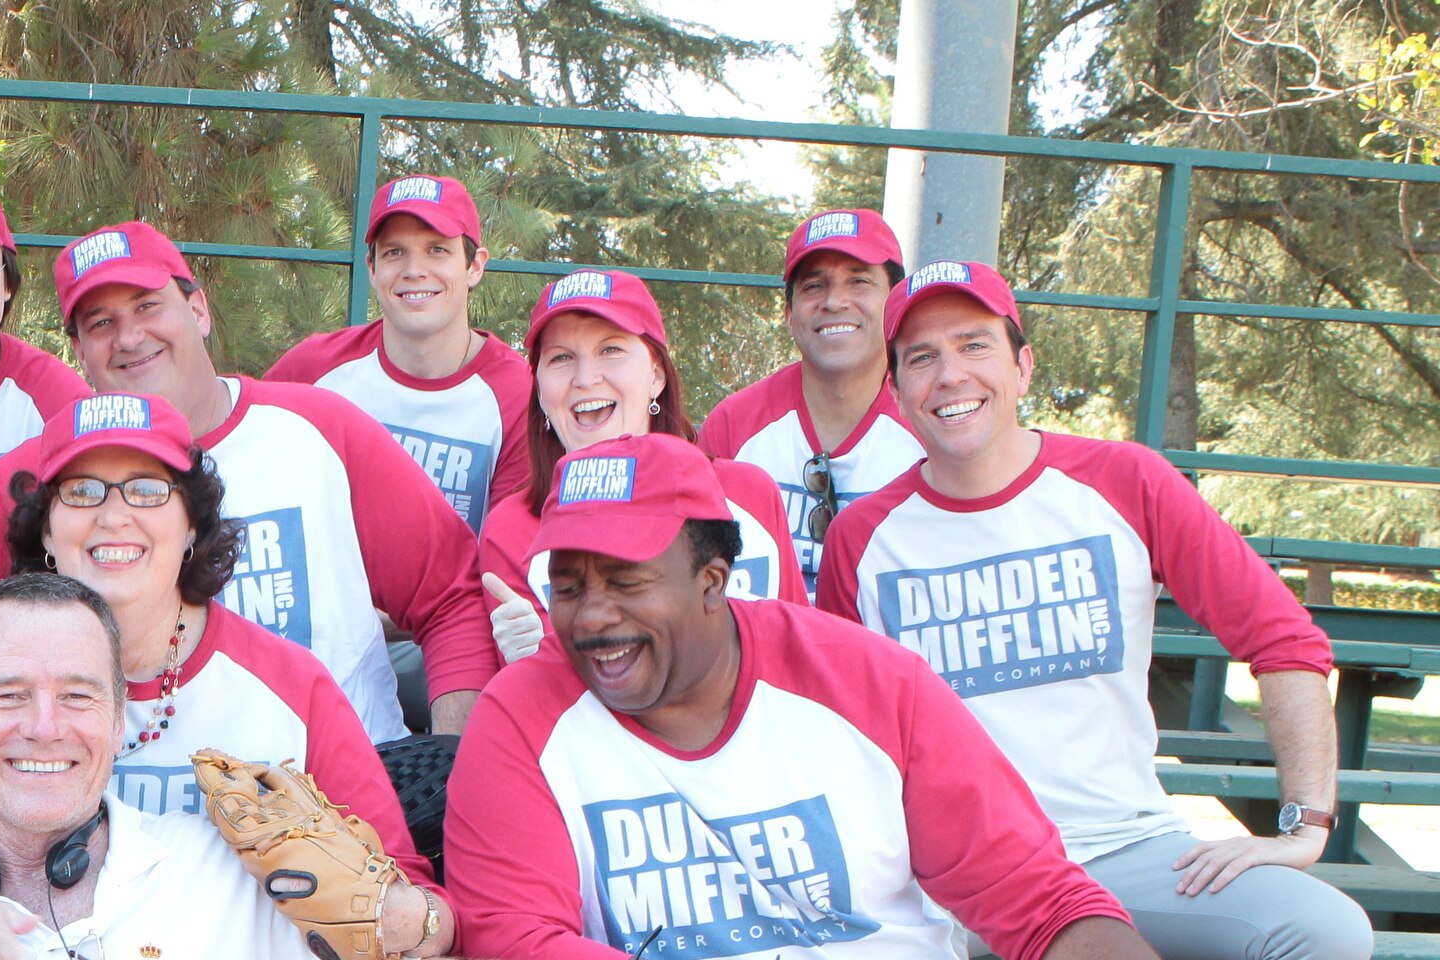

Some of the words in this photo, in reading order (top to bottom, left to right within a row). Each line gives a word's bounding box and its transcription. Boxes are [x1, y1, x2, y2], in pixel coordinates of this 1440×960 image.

[394, 177, 437, 190] DUNDER
[811, 213, 853, 229] DUNDER
[74, 232, 121, 257] DUNDER
[75, 242, 121, 271] MIFFLIN
[555, 272, 606, 289] DUNDER
[913, 261, 963, 280] DUNDER
[81, 395, 142, 412] DUNDER
[79, 408, 140, 427] MIFFLIN
[567, 458, 628, 478] DUNDER
[564, 475, 621, 496] MIFFLIN
[897, 547, 1098, 627] DUNDER
[899, 601, 1095, 674] MIFFLIN
[994, 655, 1107, 683] COMPANY
